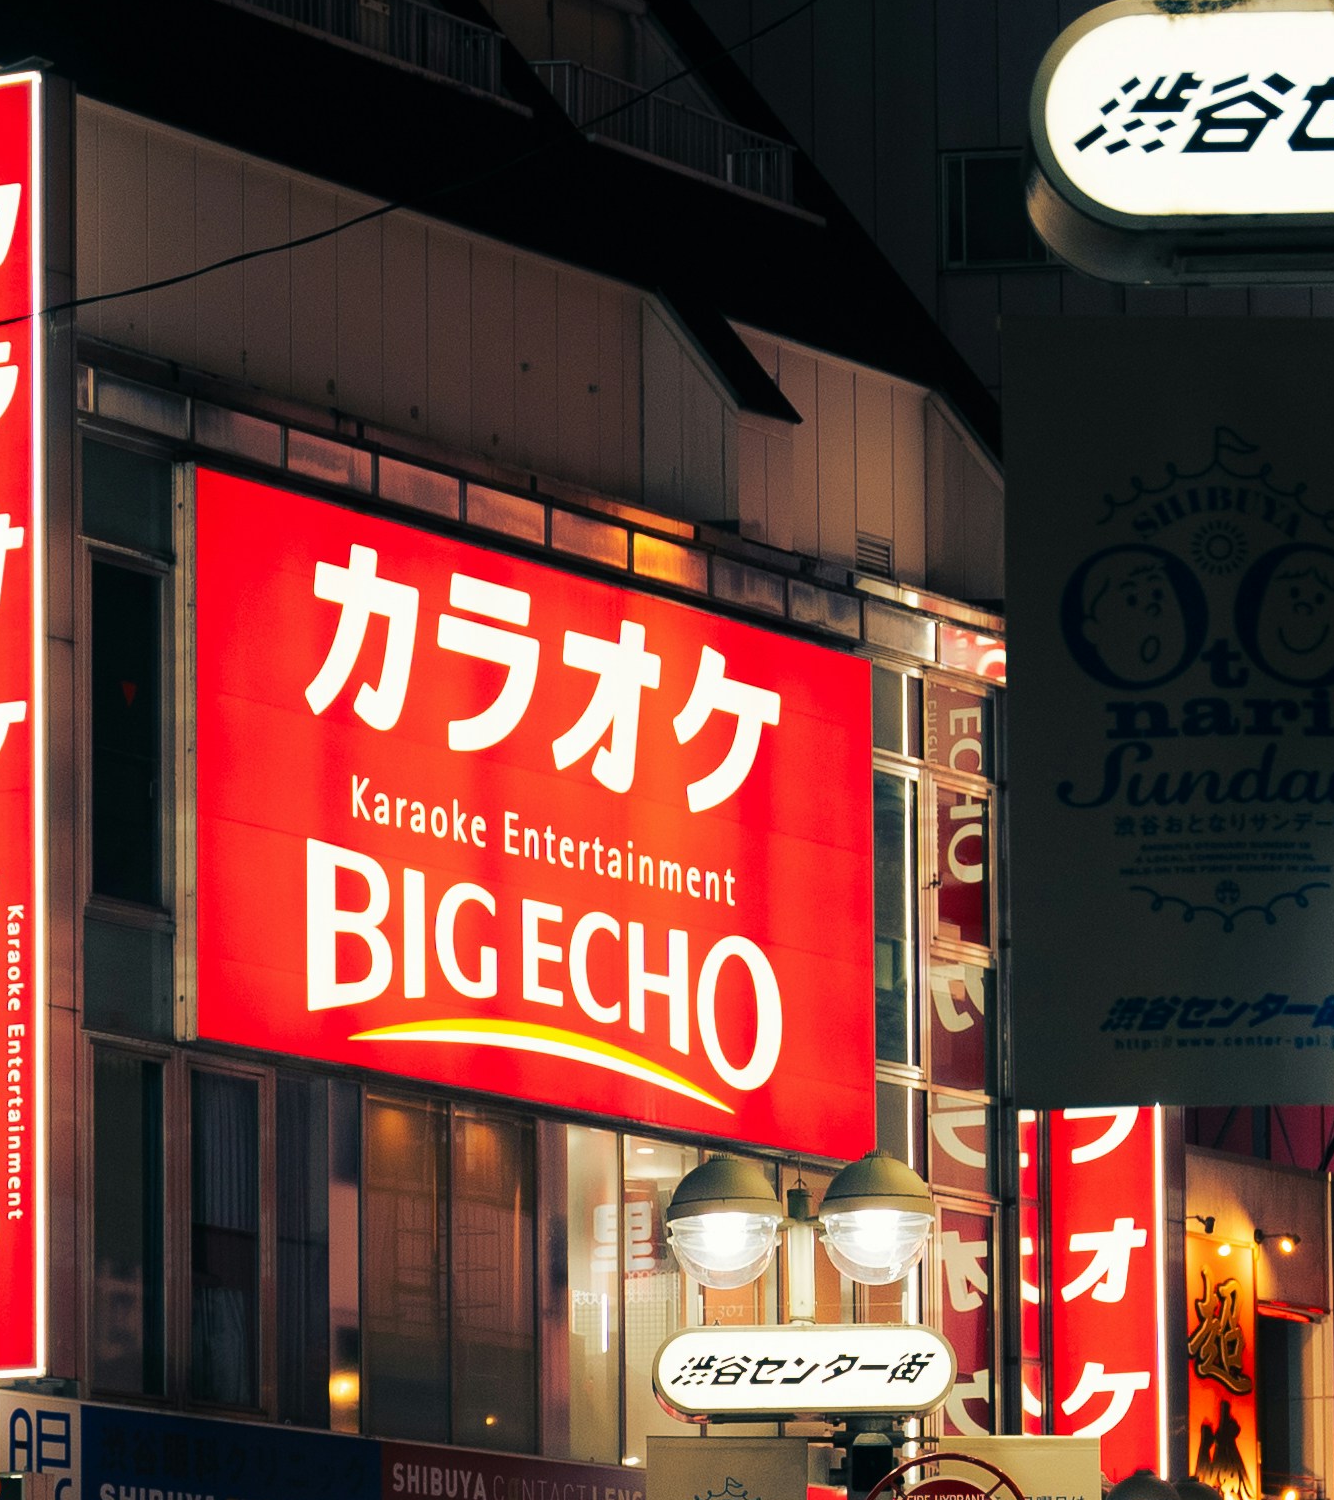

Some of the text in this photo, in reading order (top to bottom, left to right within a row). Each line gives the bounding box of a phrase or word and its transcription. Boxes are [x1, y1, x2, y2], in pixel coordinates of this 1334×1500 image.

[1134, 485, 1302, 539] SHIBUYA
[305, 543, 782, 813] カラオケ
[349, 776, 738, 908] Karaoke Entertainment
[1115, 812, 1333, 836] 渋谷おとなりサンデー
[305, 838, 784, 1092] BIG ECHO
[4, 903, 26, 1221] Karaoke Entertainment
[1060, 1105, 1153, 1437] ラオケ
[670, 1352, 936, 1386] 渋谷センター街
[391, 1462, 488, 1500] SHIBUYA
